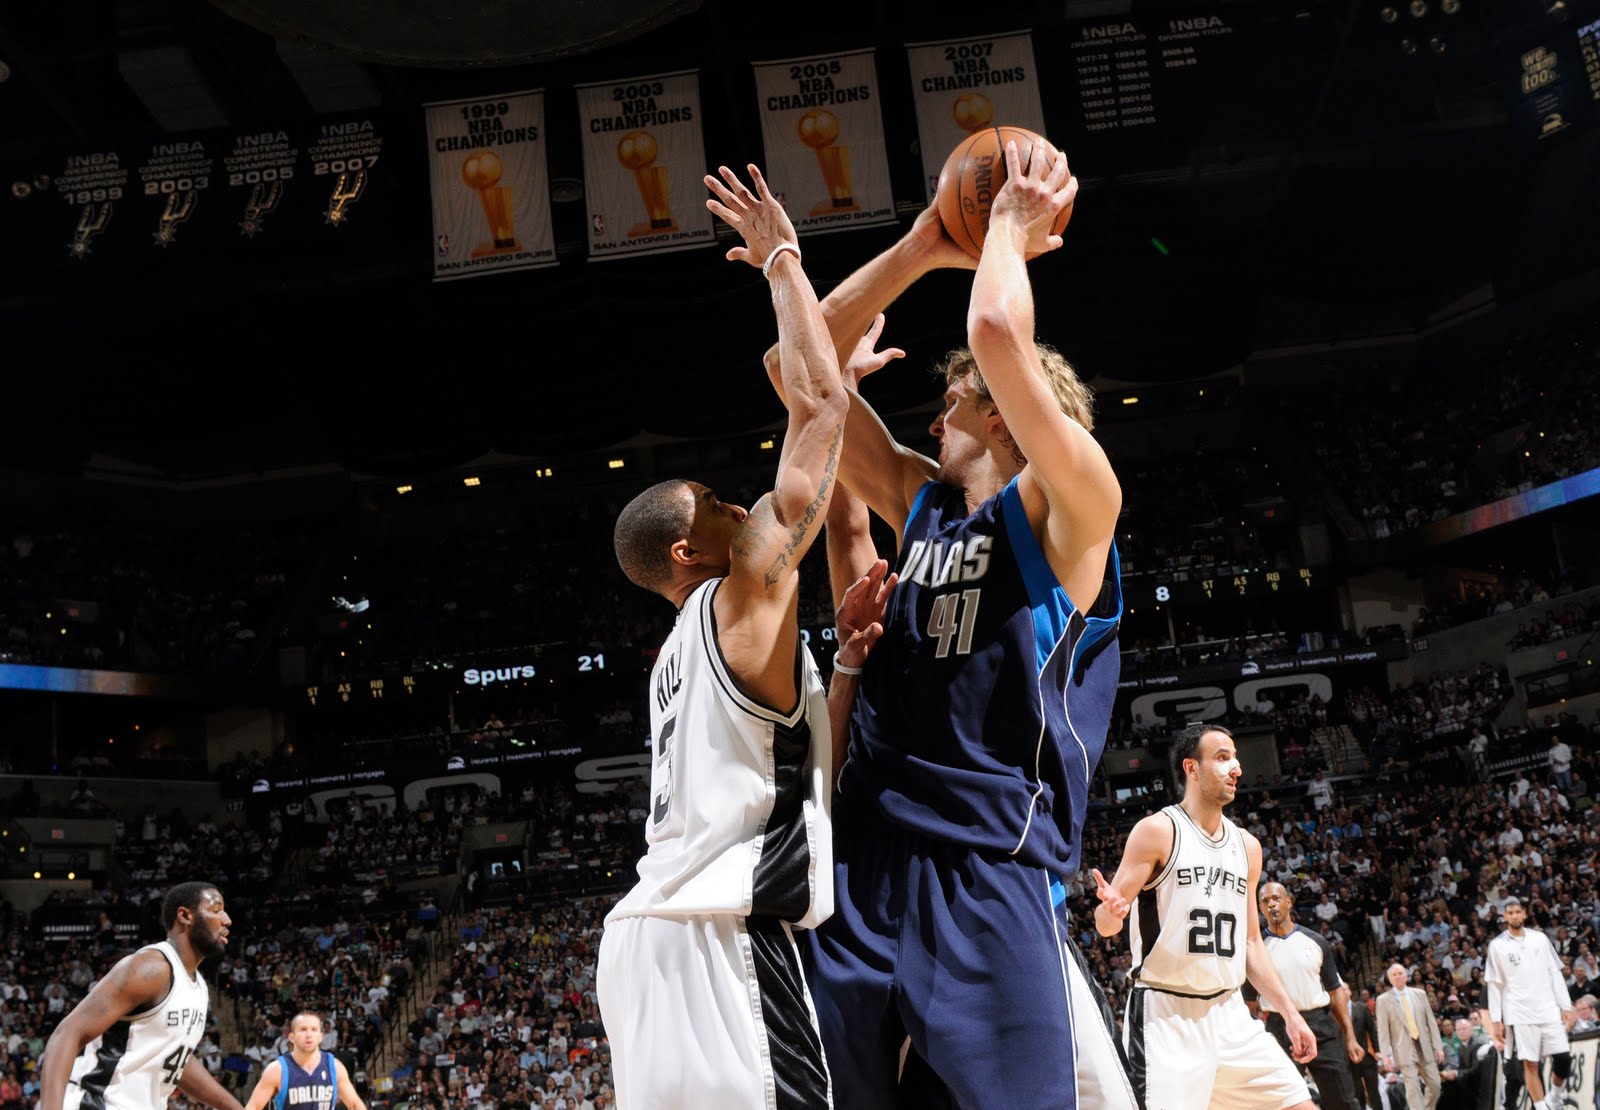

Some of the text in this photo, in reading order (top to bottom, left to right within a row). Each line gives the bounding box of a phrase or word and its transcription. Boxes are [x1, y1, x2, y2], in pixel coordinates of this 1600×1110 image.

[1090, 21, 1136, 38] NBA
[1177, 16, 1223, 30] NBA
[1070, 38, 1112, 48] DIVISION
[1158, 31, 1200, 42] DIVISION
[945, 43, 993, 60] 2007
[790, 61, 841, 79] 2005
[953, 58, 990, 75] NBA
[798, 77, 835, 94] NBA
[922, 67, 1025, 92] CHAMPIONS
[613, 82, 664, 100] 2003
[767, 86, 870, 111] CHAMPIONS
[461, 102, 509, 120] 1999
[622, 98, 657, 115] NBA
[330, 120, 375, 136] NBA
[468, 118, 503, 134] NBA
[590, 107, 693, 132] CHAMPIONS
[245, 131, 288, 146] NBA
[436, 126, 538, 152] CHAMPIONS
[159, 140, 205, 156] NBA
[75, 152, 119, 167] NBA
[313, 155, 379, 176] 2007
[144, 176, 208, 196] 2003
[229, 167, 294, 187] 2005
[64, 187, 123, 206] 1999
[801, 213, 851, 226] ANTONIO
[854, 208, 891, 219] SPURS
[593, 229, 710, 250] SAN ANTONIO SPURS
[437, 249, 552, 270] SAN ANTONIO SPURS
[1202, 568, 1312, 590] ST AS RB BL
[1239, 586, 1246, 595] 2
[1271, 581, 1278, 591] 6
[1155, 585, 1170, 602] 8
[927, 588, 981, 659] 41
[463, 653, 605, 687] Spurs 21
[307, 675, 416, 697] ST AS RB BL
[1176, 866, 1247, 898] SPURS
[1188, 907, 1238, 959] 20
[288, 1084, 334, 1105] DALLAS
